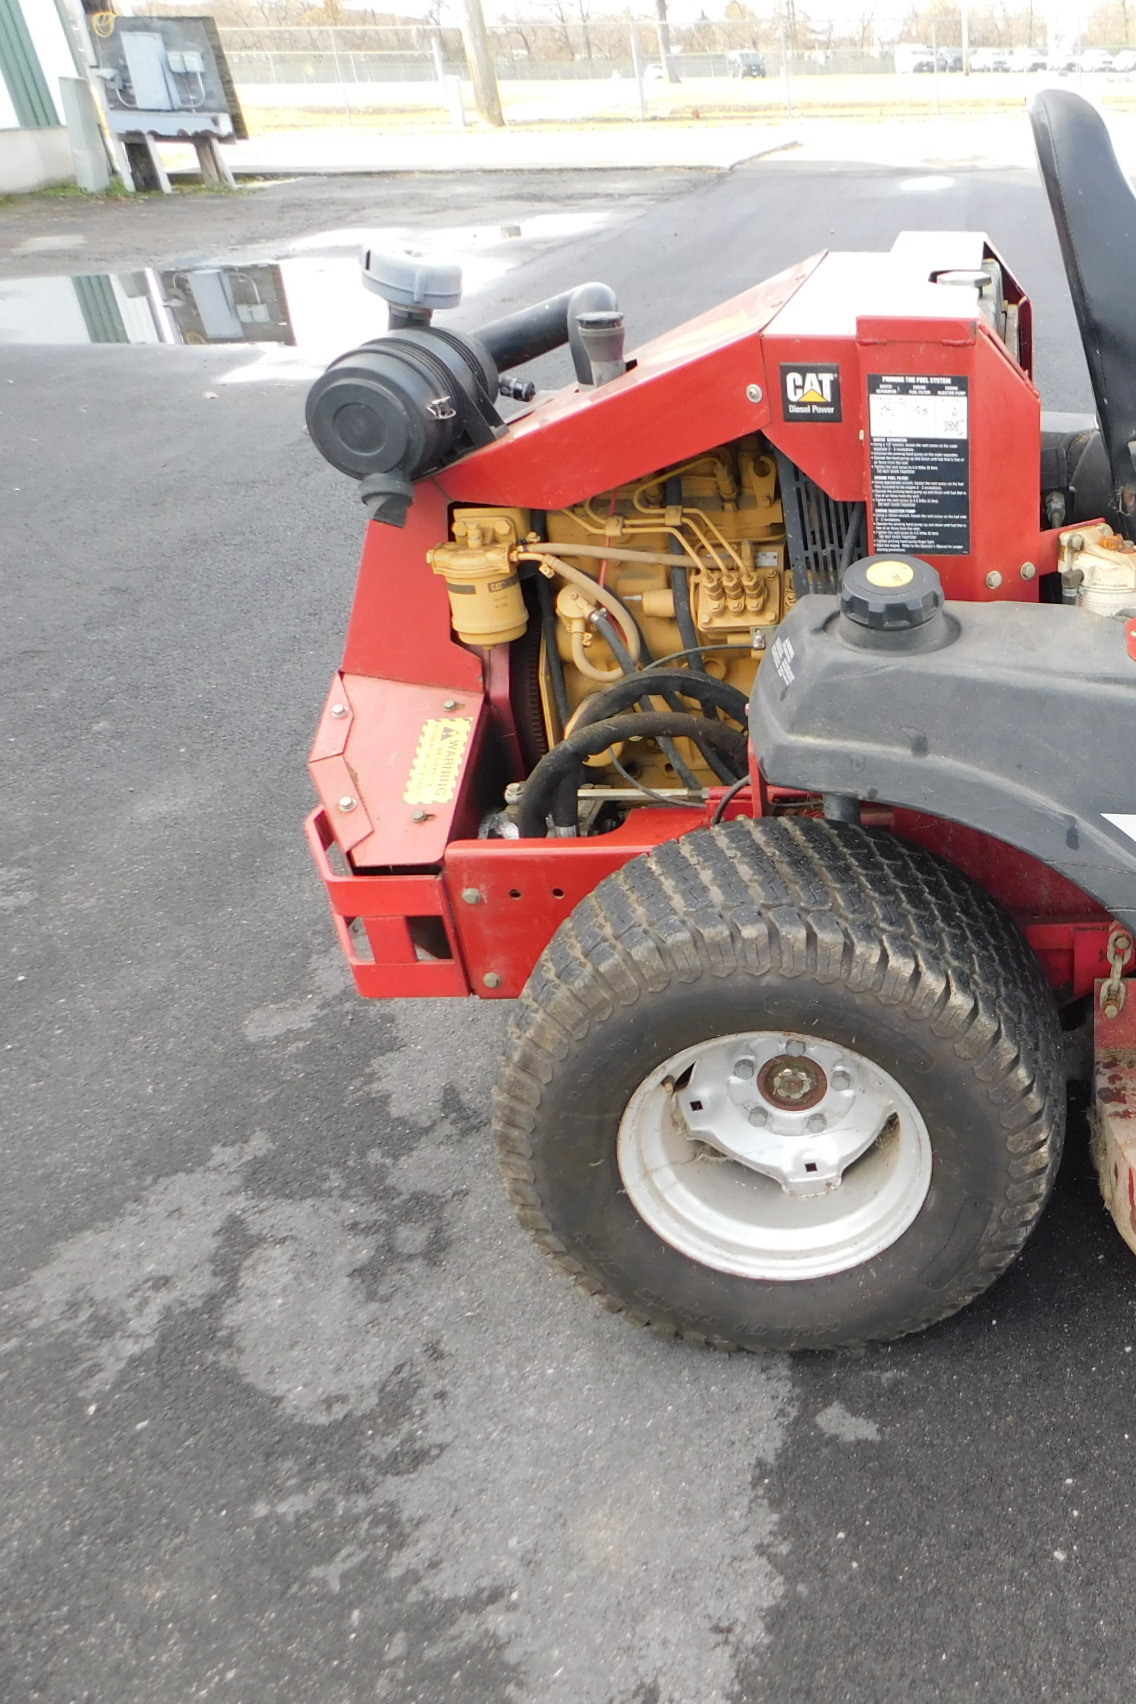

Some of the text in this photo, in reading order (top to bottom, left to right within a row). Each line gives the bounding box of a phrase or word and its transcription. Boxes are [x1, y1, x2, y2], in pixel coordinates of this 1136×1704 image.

[786, 372, 834, 402] CAT
[789, 404, 834, 414] Diesel Power
[435, 739, 459, 796] WARNING
